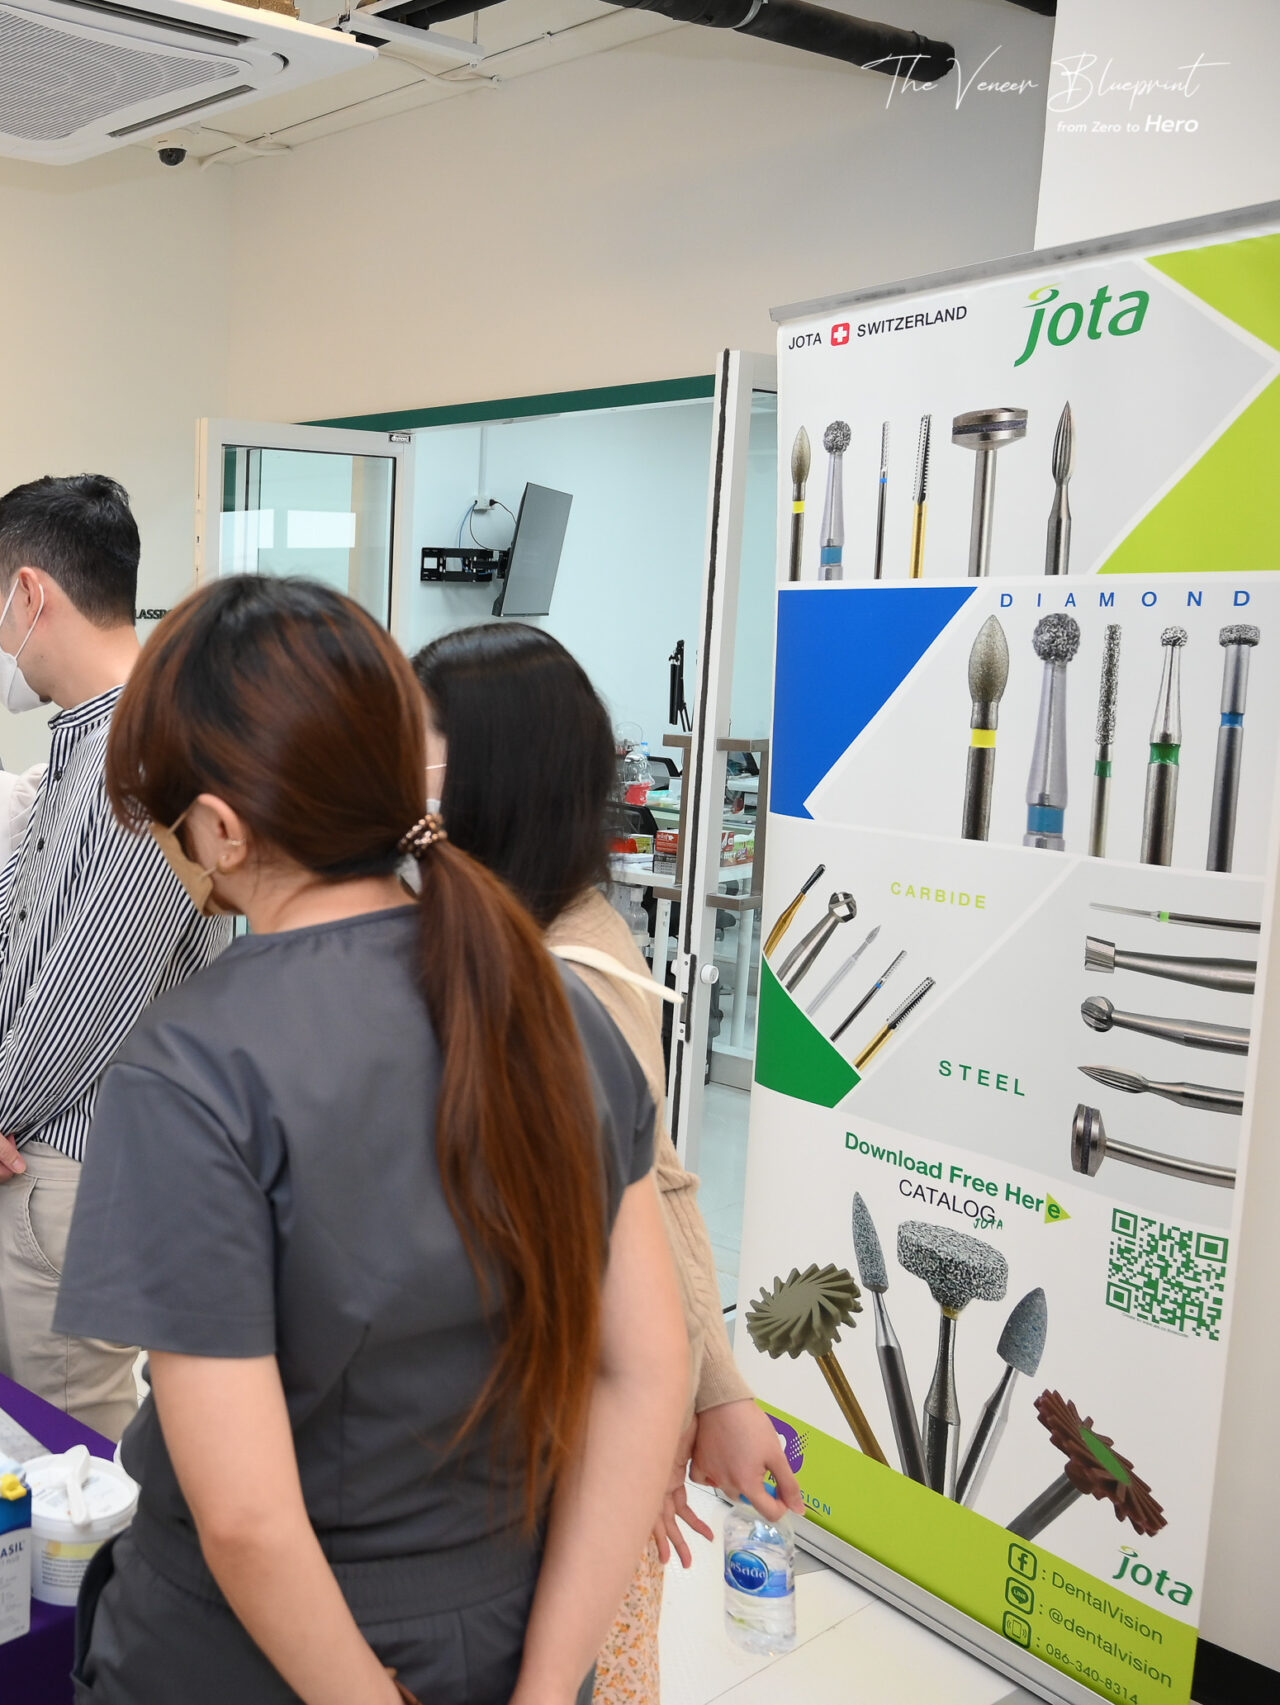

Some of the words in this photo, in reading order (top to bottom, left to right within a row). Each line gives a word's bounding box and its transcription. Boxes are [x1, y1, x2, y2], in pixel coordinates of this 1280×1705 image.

[788, 332, 822, 350] JOTA
[857, 305, 967, 338] SWITZERLAND
[1014, 282, 1150, 368] jota
[1000, 590, 1251, 608] DIAMOND
[890, 881, 987, 909] CARBIDE
[938, 1060, 1026, 1097] STEEL
[845, 1131, 943, 1180] Download
[949, 1165, 999, 1197] Free
[1005, 1182, 1061, 1220] Here
[898, 1179, 996, 1224] CATALOG
[800, 1489, 832, 1516] SION
[1112, 1545, 1194, 1606] jota
[1051, 1571, 1163, 1645] DentalVision
[1046, 1643, 1139, 1704] 086-340-8314
[1048, 1607, 1173, 1689] @dentalvision
